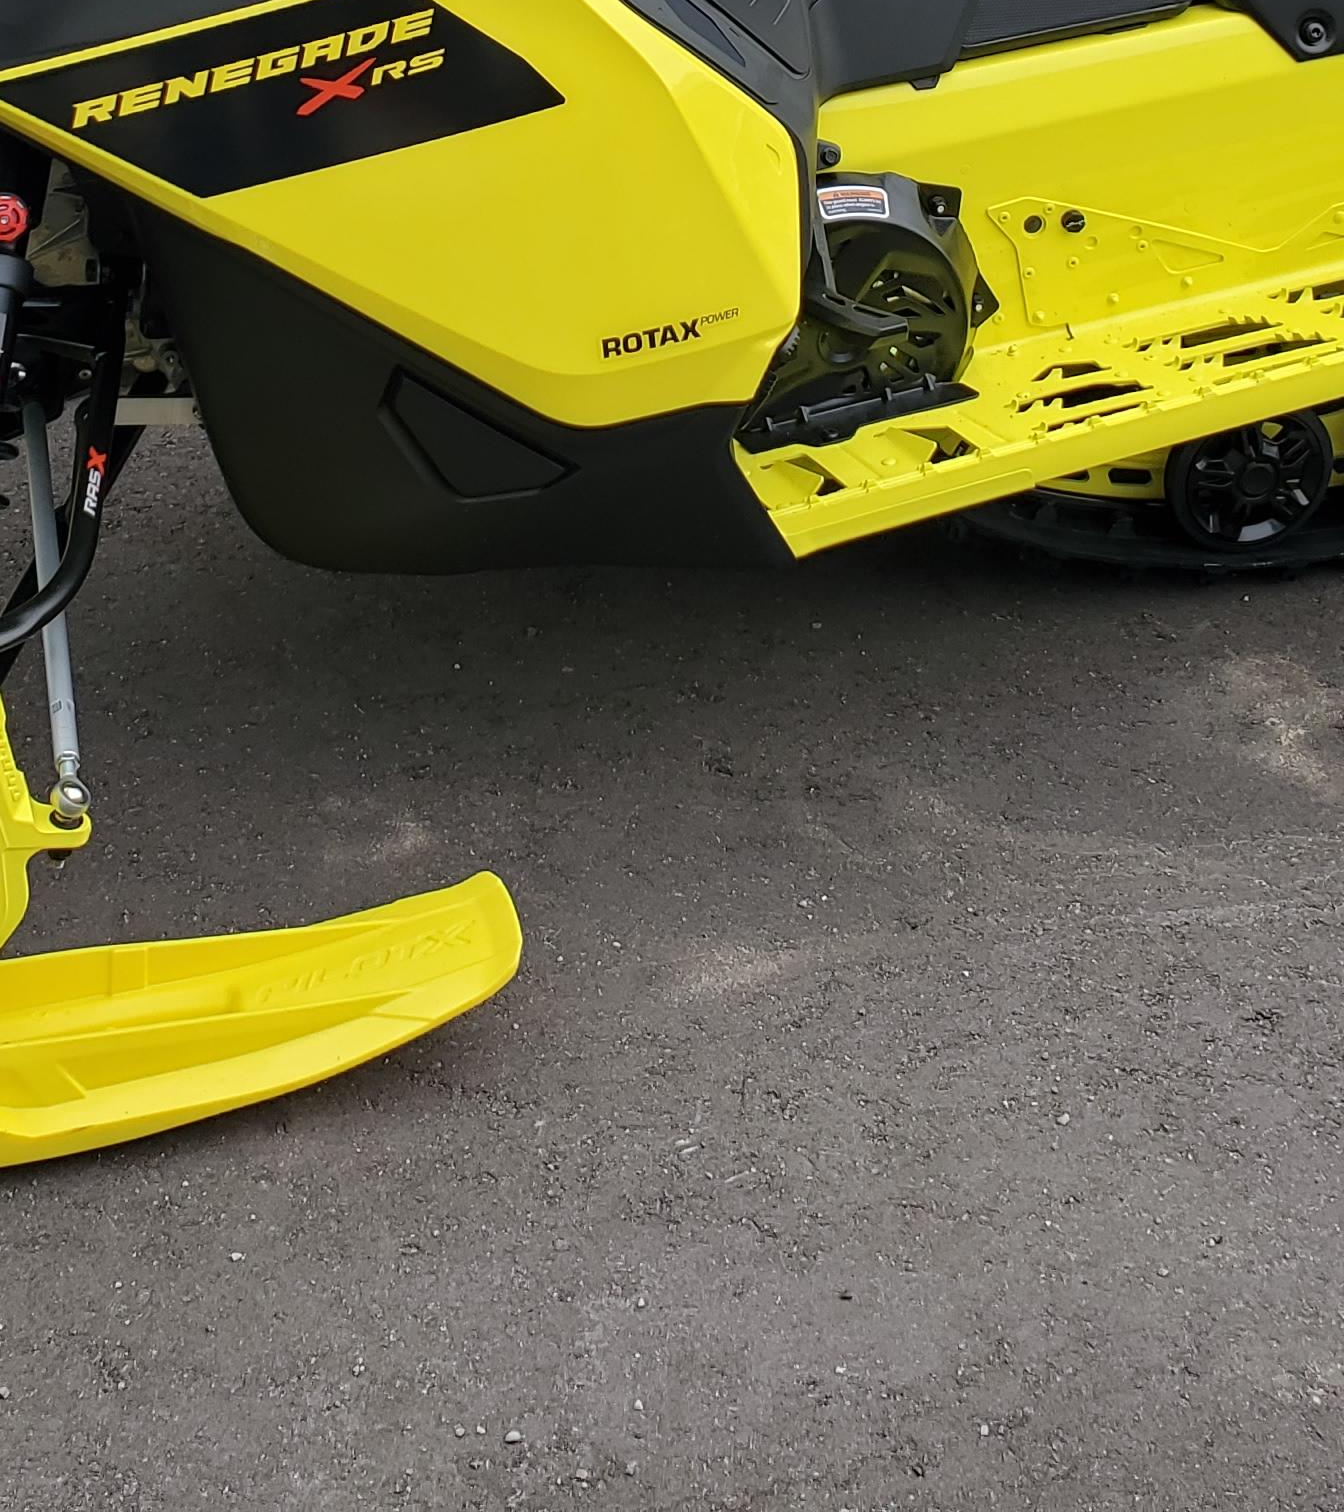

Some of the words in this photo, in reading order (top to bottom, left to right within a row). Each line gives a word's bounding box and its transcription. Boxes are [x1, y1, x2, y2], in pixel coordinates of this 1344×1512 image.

[72, 8, 435, 128] RENEGADE
[601, 318, 702, 358] ROTAX
[700, 307, 739, 326] POWER
